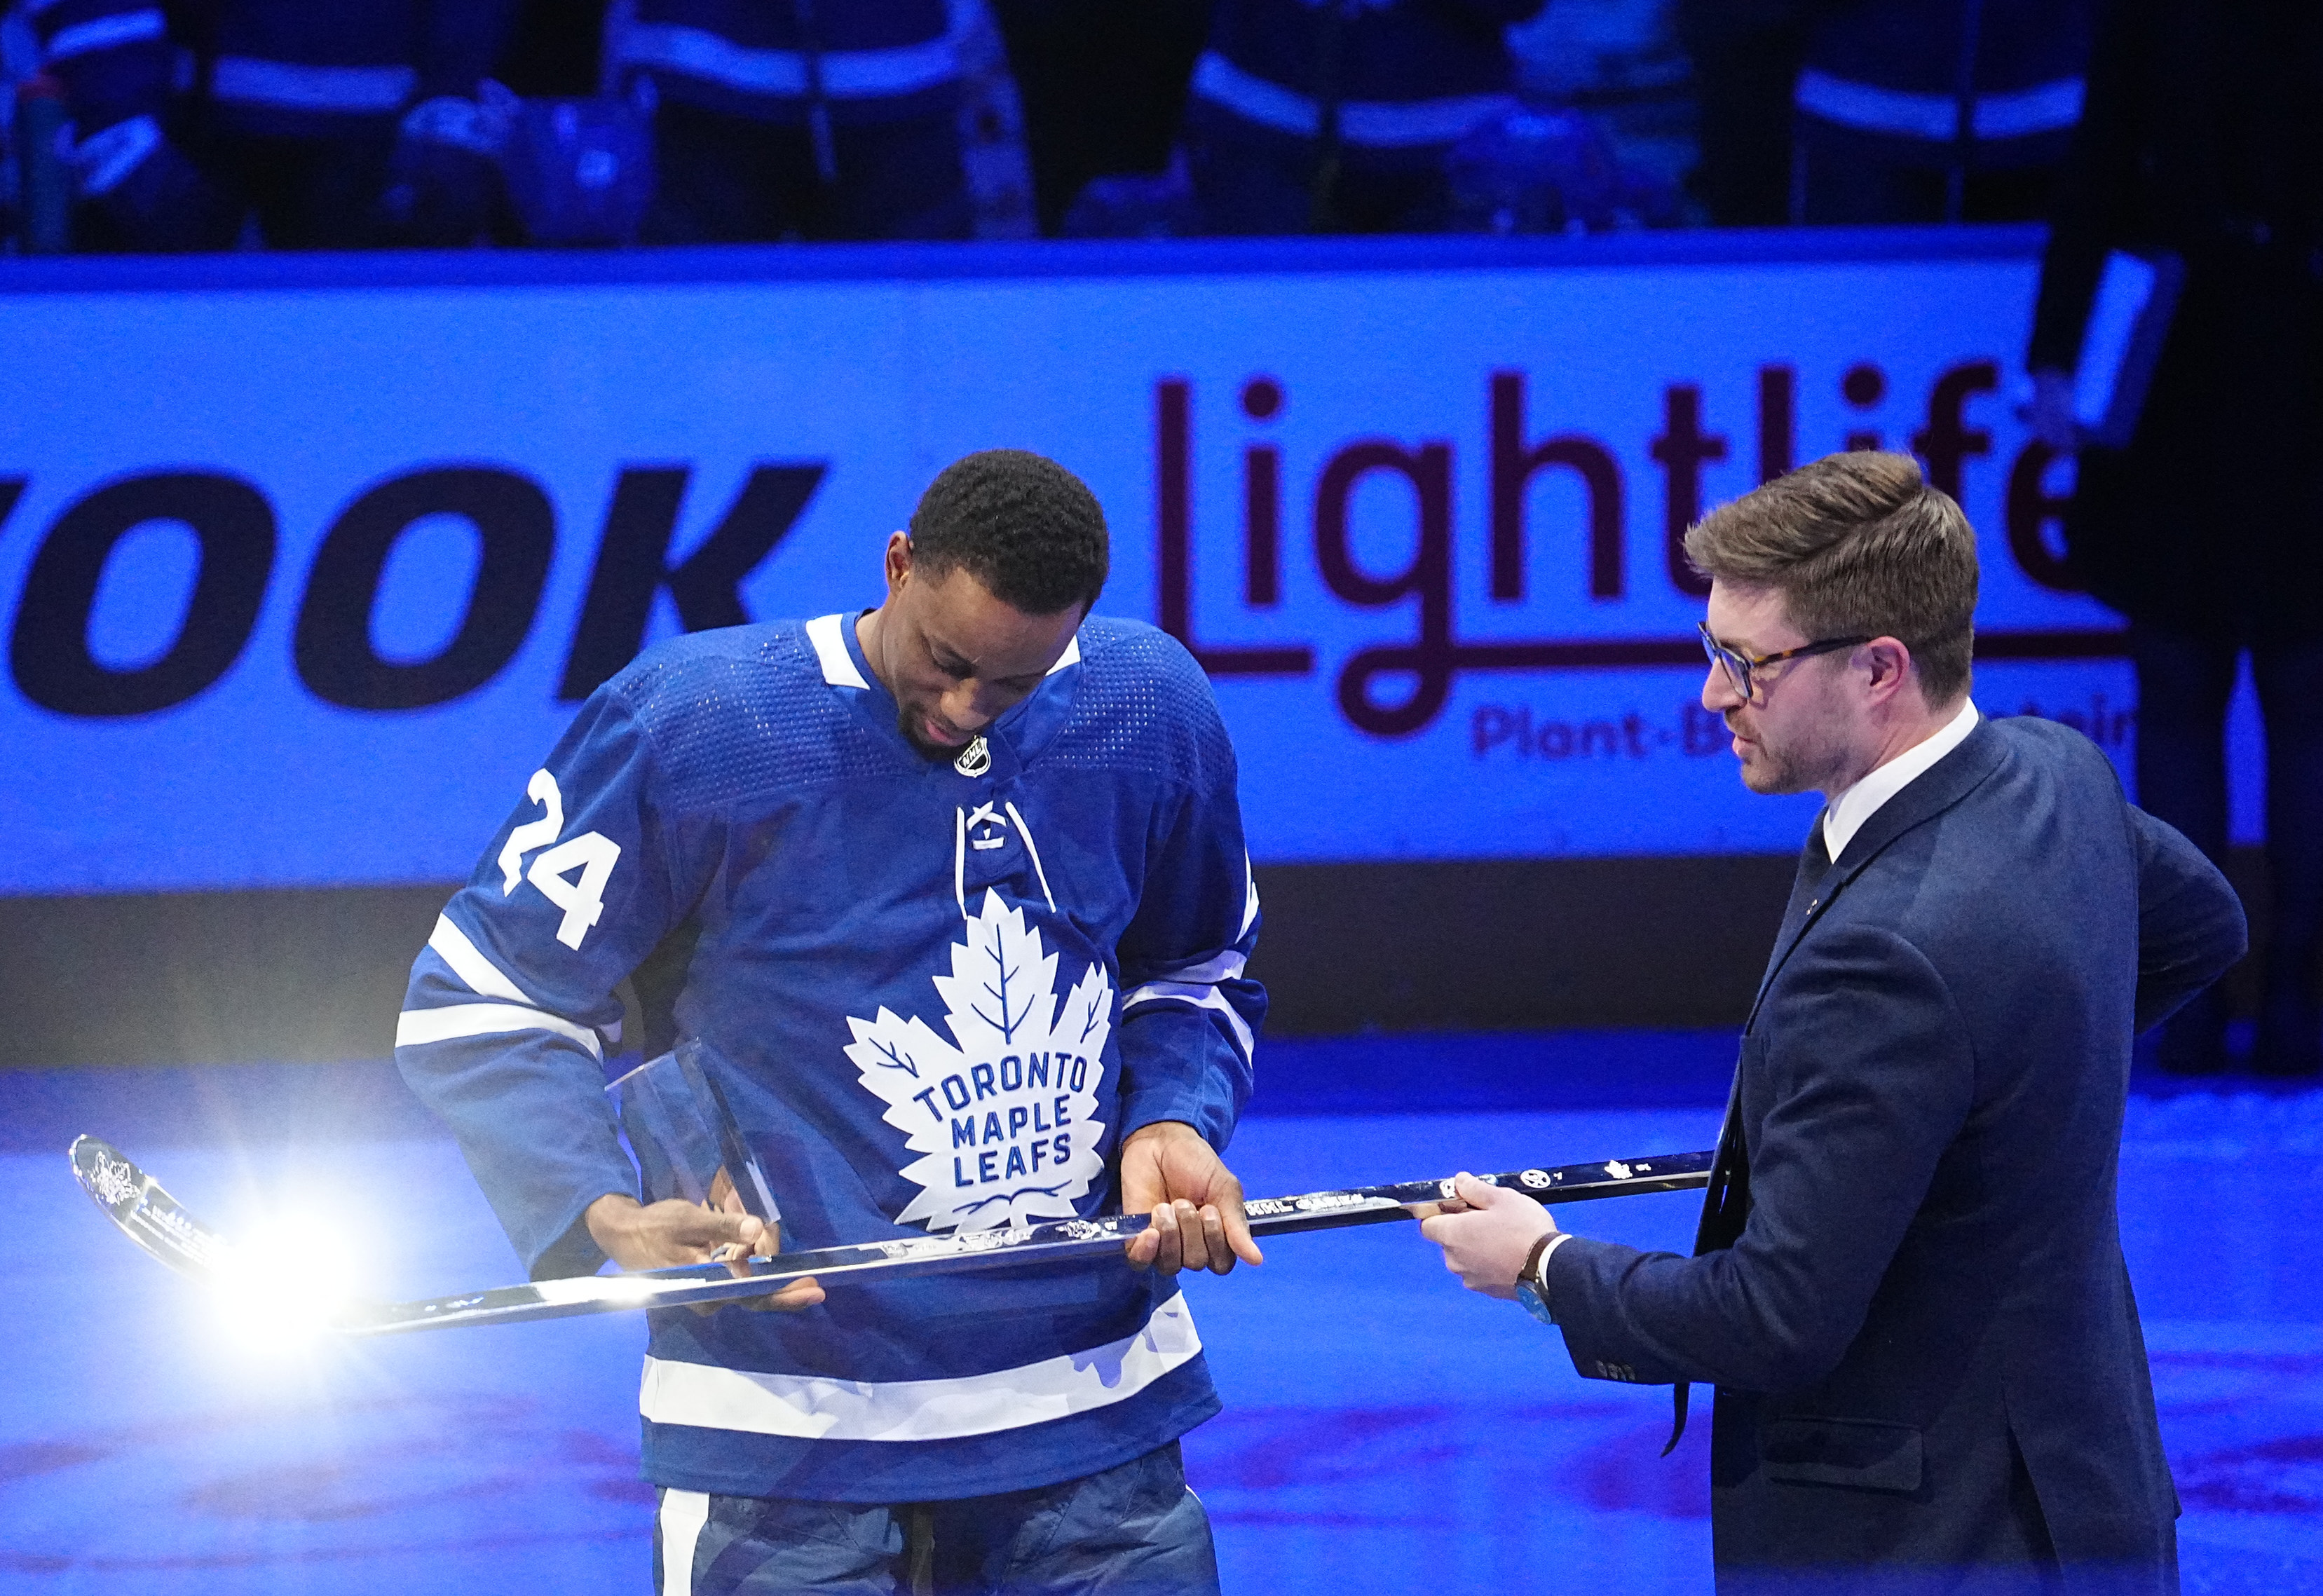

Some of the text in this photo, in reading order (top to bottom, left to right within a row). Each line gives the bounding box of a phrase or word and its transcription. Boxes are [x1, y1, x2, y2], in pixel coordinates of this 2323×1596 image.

[0, 464, 830, 719] OOK
[963, 744, 982, 767] NHL
[1473, 700, 1736, 760] Plant-B
[498, 768, 621, 951] 24
[913, 1051, 1087, 1122] TORONTO
[951, 1093, 1071, 1150] MAPLE
[953, 1133, 1071, 1188] LEAFS
